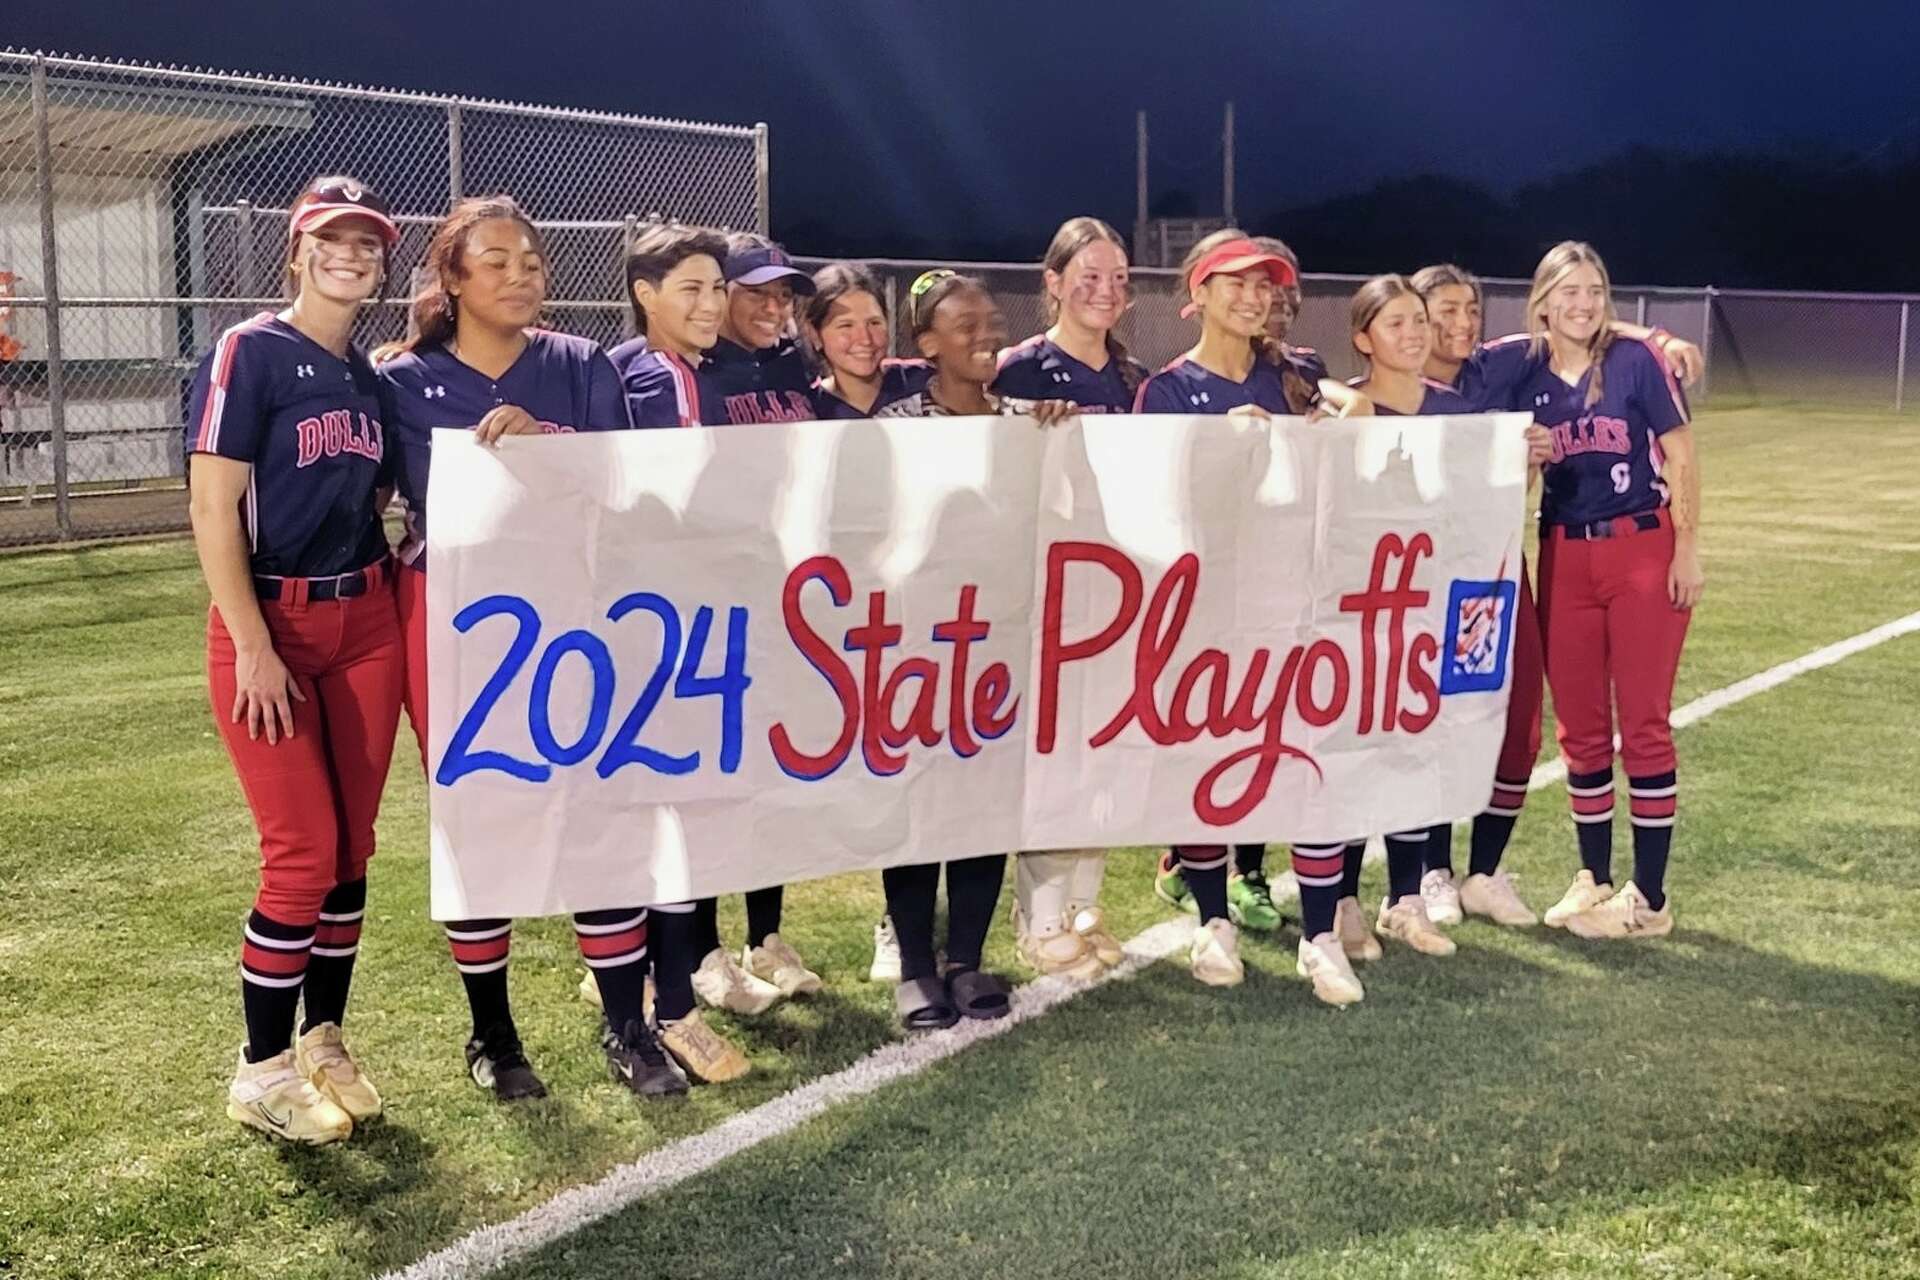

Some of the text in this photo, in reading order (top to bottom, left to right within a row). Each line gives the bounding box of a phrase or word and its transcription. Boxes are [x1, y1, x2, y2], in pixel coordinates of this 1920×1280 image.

[1551, 416, 1632, 464] ULLES
[436, 533, 1441, 826] 2024 State Playoffs
